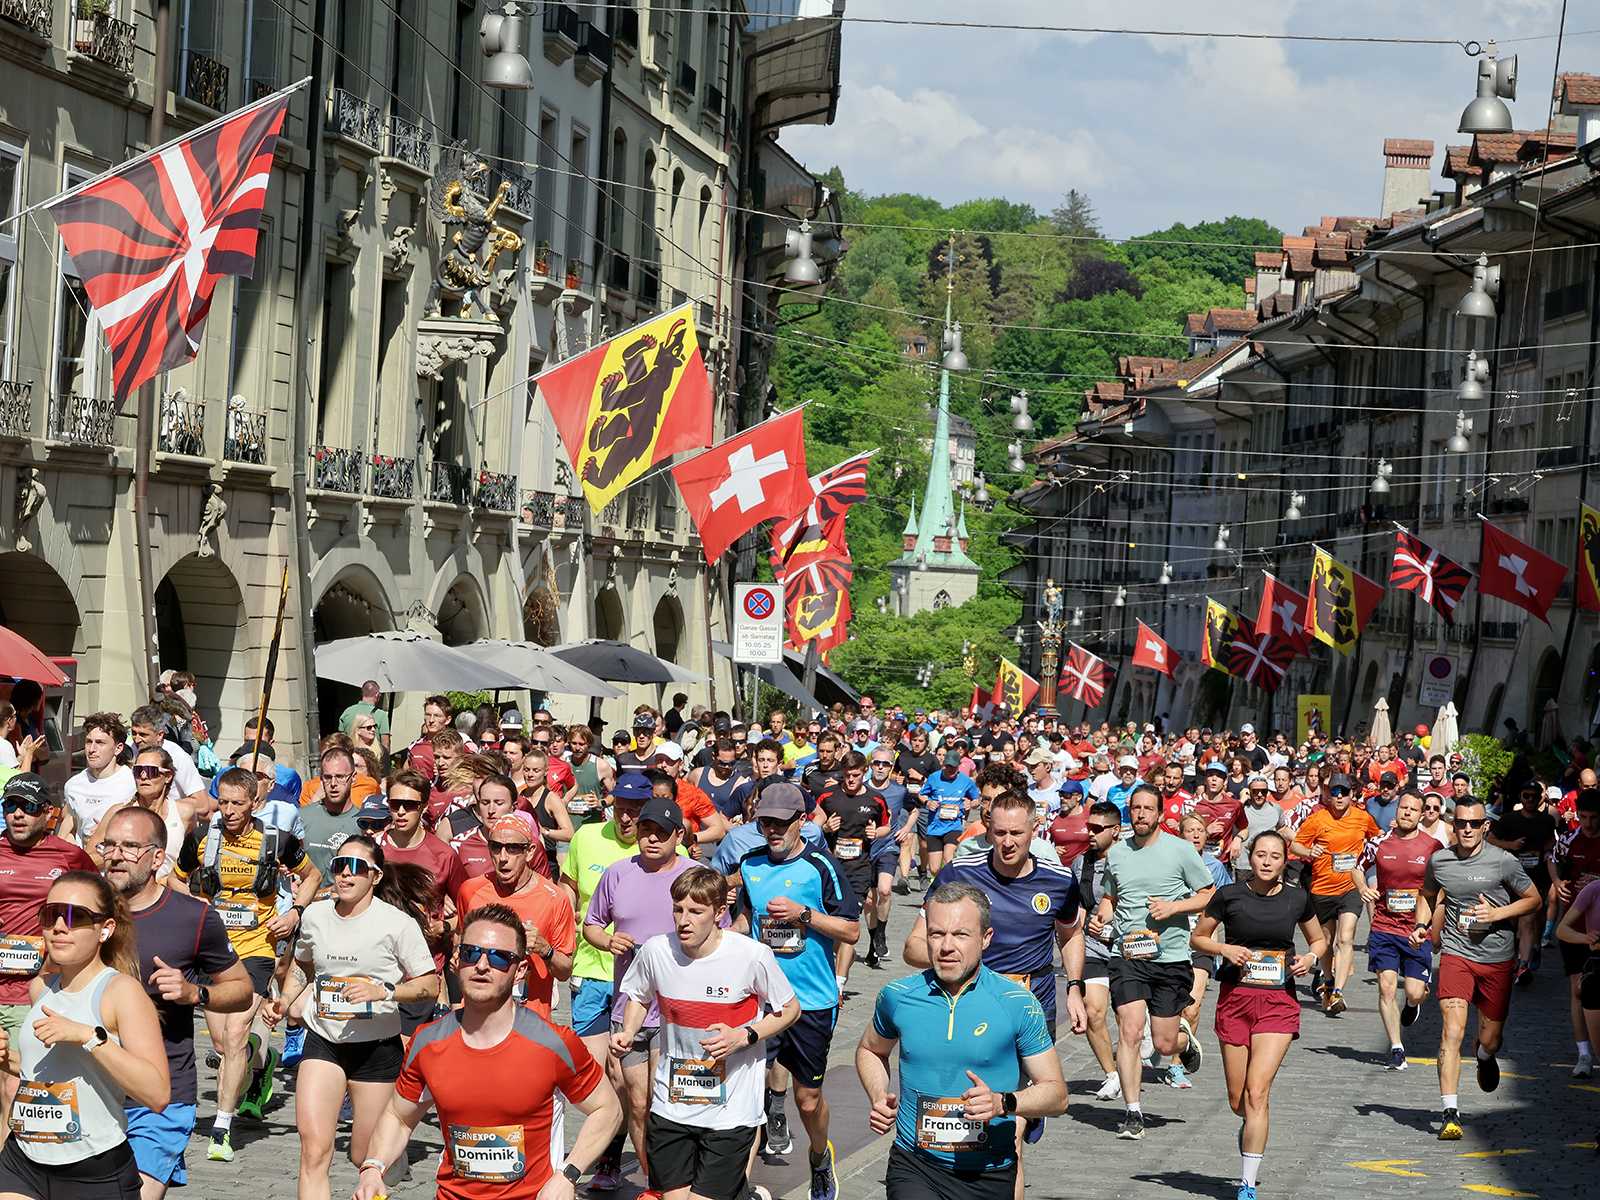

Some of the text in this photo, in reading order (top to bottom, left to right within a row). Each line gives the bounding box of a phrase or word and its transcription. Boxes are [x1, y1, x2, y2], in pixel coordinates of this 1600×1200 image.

[767, 930, 794, 939] Daniel
[1123, 939, 1156, 950] Matthias
[1246, 963, 1278, 971] Jasmin
[320, 980, 343, 988] CRAFT
[673, 1063, 705, 1071] BERNEXPO
[677, 1077, 716, 1087] Manuel
[922, 1101, 965, 1111] BERNEXPO
[18, 1105, 63, 1119] Valérie
[924, 1118, 982, 1131] Francois
[453, 1130, 497, 1141] BERNEXPO
[457, 1148, 515, 1161] Dominik
